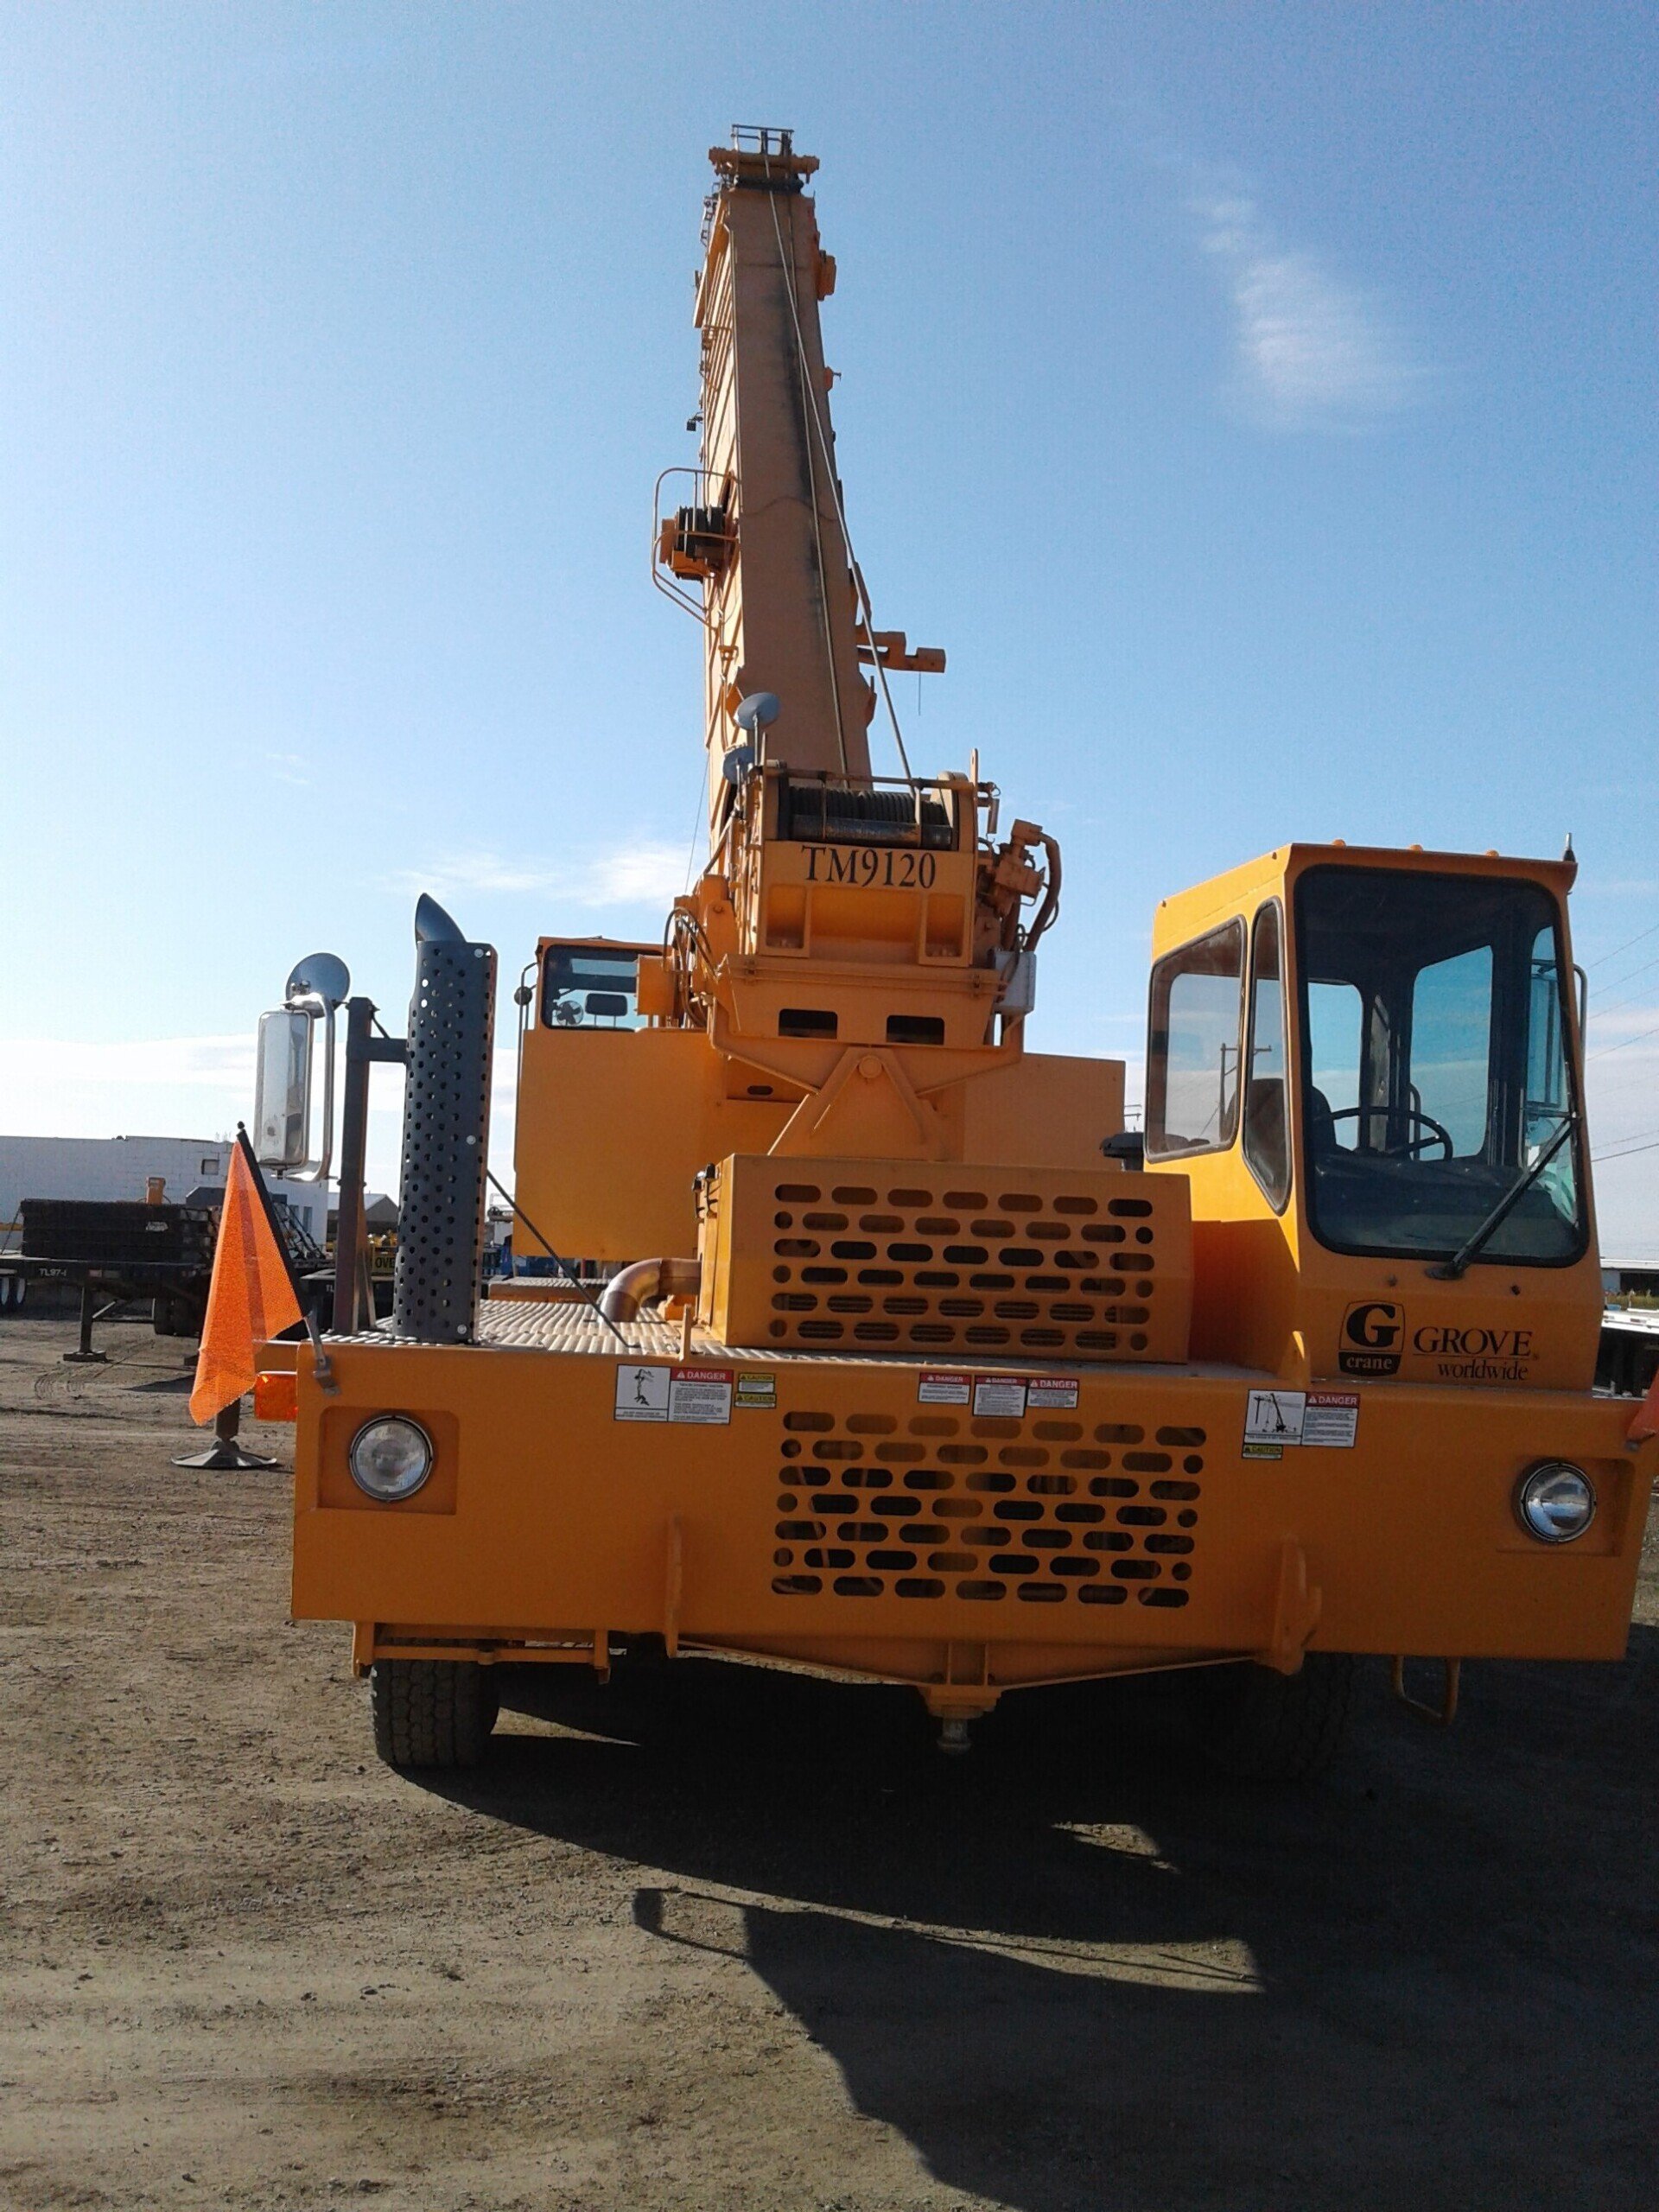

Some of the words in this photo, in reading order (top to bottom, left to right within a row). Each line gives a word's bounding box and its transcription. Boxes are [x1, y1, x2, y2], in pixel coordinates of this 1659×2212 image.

[801, 845, 936, 888] TM9120
[1346, 1304, 1401, 1348] G
[1413, 1326, 1534, 1357] GROVE
[1345, 1355, 1393, 1370] crane
[687, 1370, 726, 1381] DANGER
[1438, 1360, 1529, 1381] worldwide
[935, 1375, 964, 1383] DANGER
[1039, 1379, 1077, 1389] DANGER
[743, 1393, 775, 1402] CAUTION
[1318, 1395, 1357, 1405] DANGER
